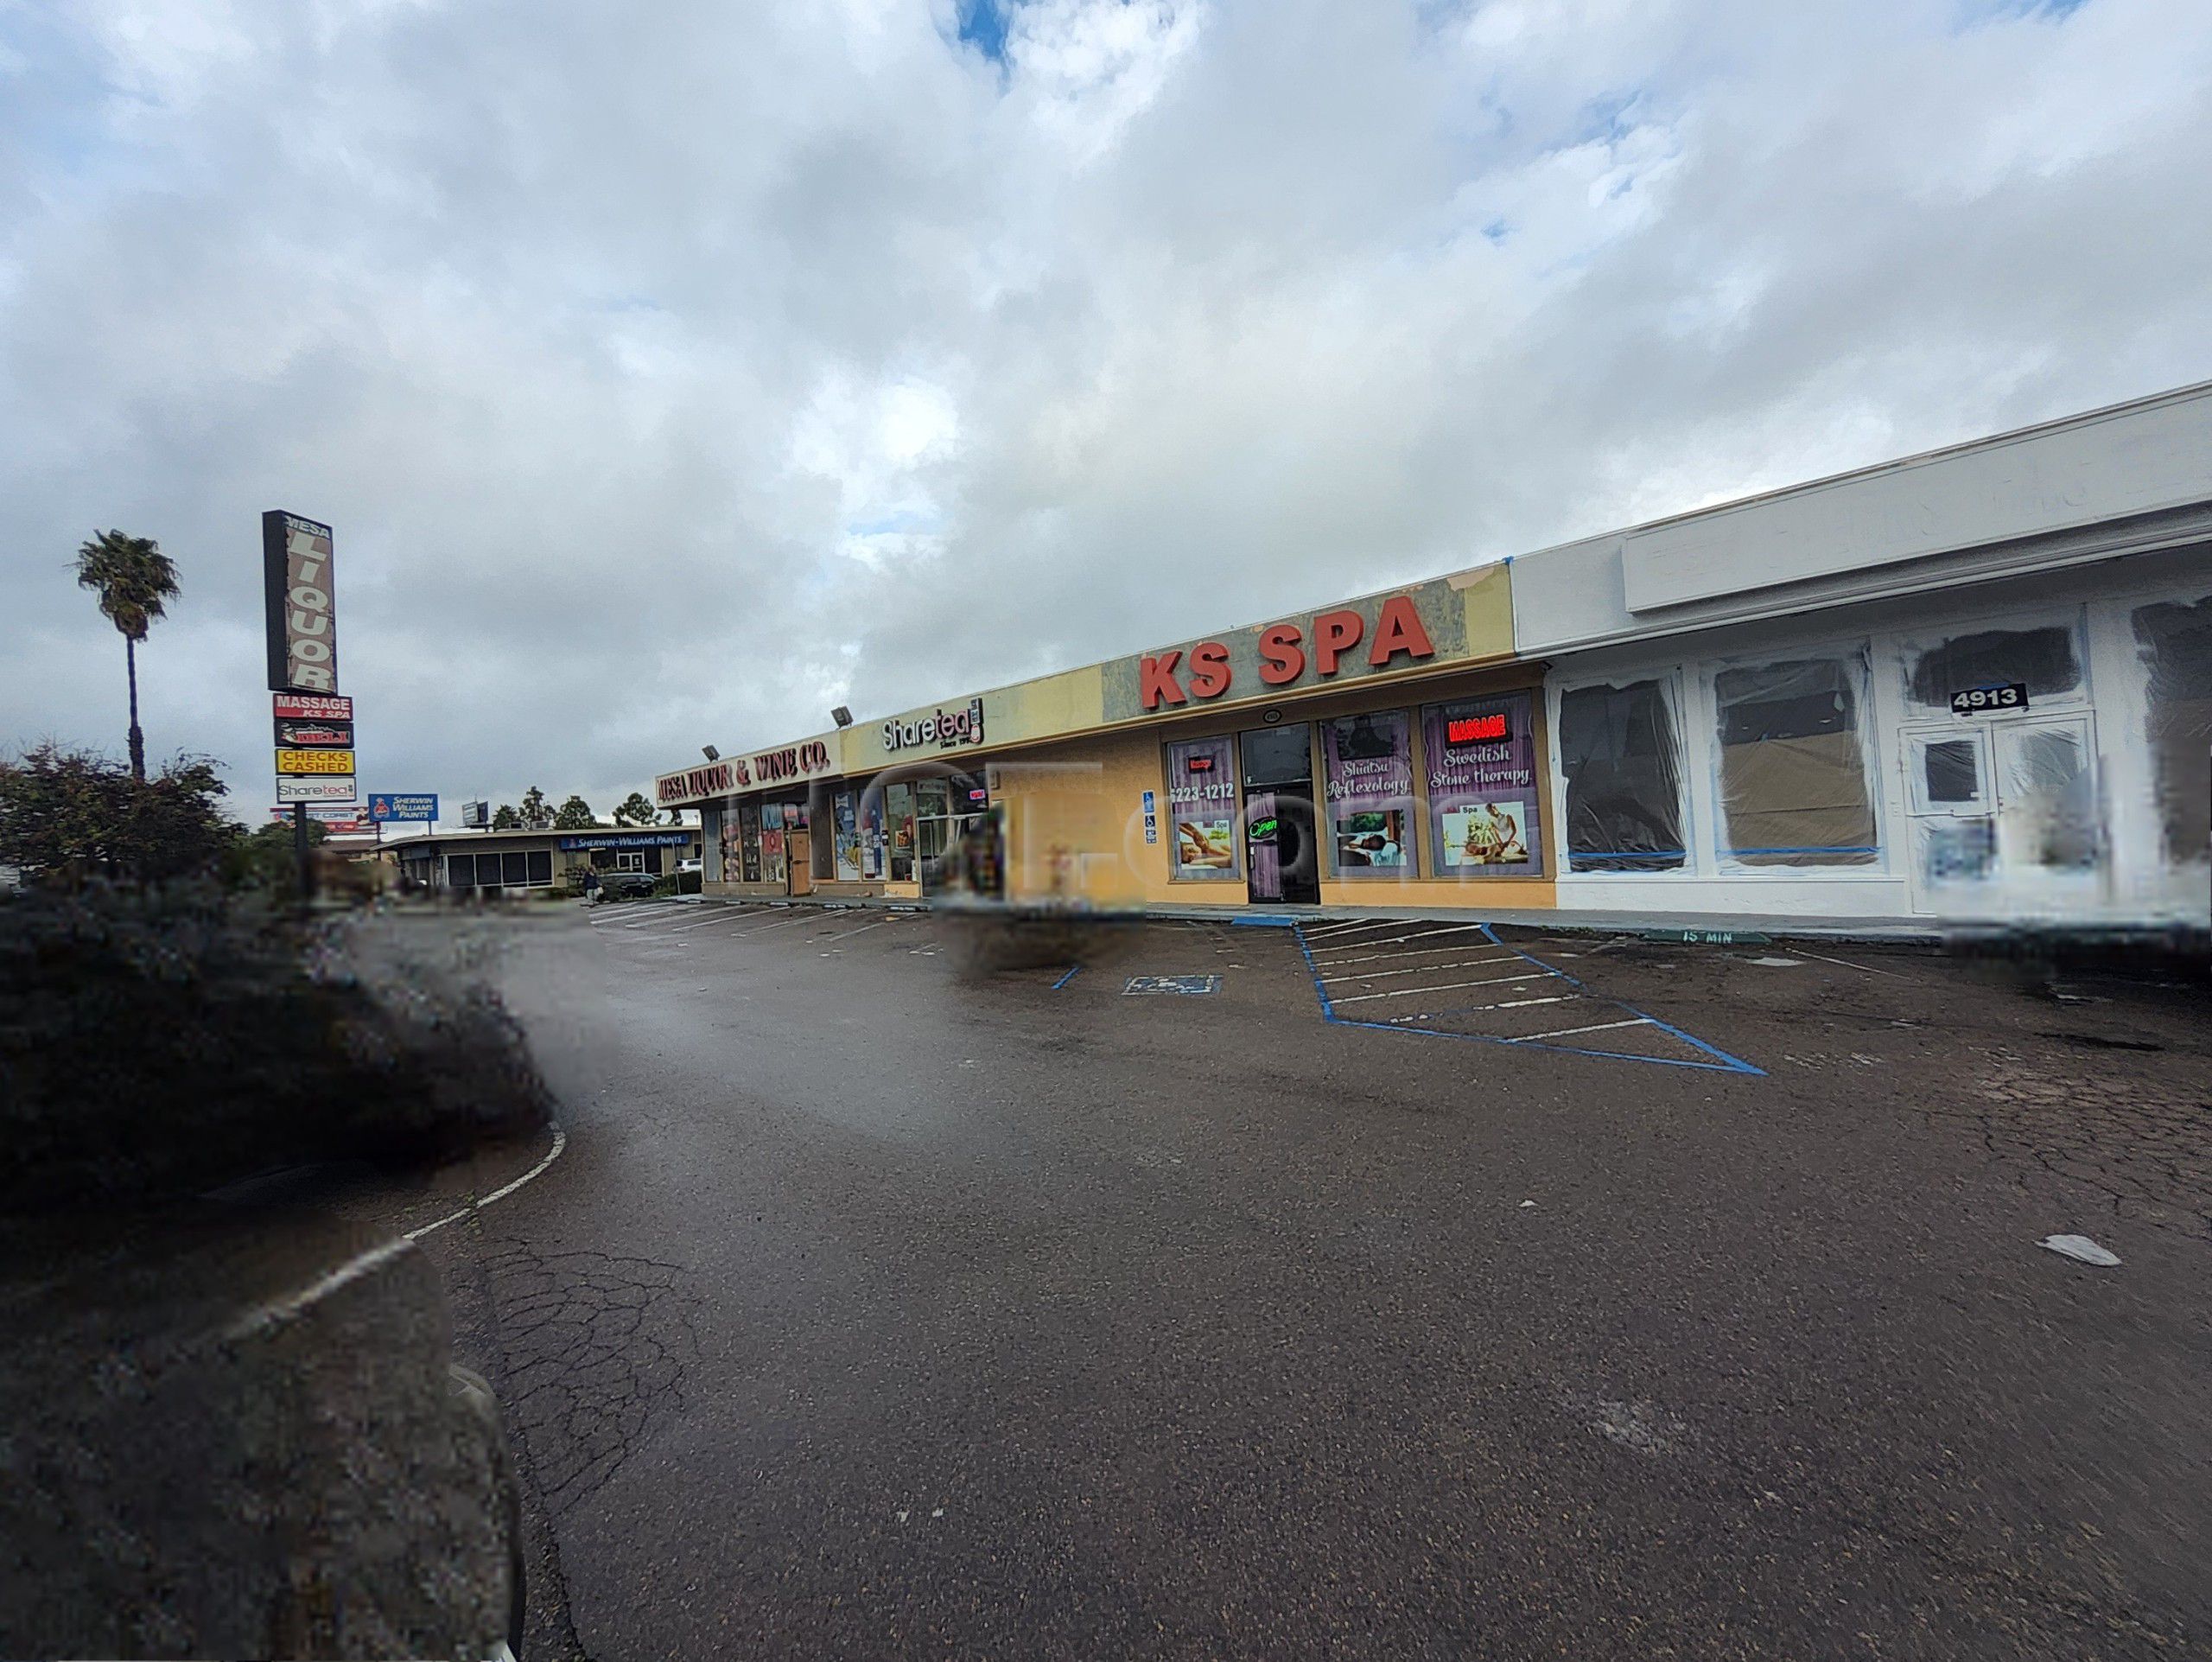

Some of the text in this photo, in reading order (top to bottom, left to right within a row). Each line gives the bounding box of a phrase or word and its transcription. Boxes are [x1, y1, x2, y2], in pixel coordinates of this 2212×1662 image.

[284, 516, 330, 538] MESA
[1140, 595, 1434, 710] KS SPA
[276, 695, 351, 710] MASSAGE
[1954, 688, 2018, 707] 4913
[882, 710, 969, 750] Sharetea
[1448, 714, 1506, 742] MASSAGE
[283, 752, 348, 762] CHECKS
[1443, 744, 1511, 767] Swedish
[283, 761, 348, 772] CASHED
[658, 741, 830, 802] MESA LIQUOR & WINE CO.
[1431, 768, 1529, 787] Stone therapy
[278, 785, 347, 796] Sharetea
[1326, 776, 1408, 799] Reflexology
[392, 802, 435, 812] WILLIAMS
[393, 796, 434, 805] SHERWIN
[1462, 806, 1478, 814] Spa
[1249, 818, 1278, 837] Open
[1682, 931, 1732, 944] 15 MIN
